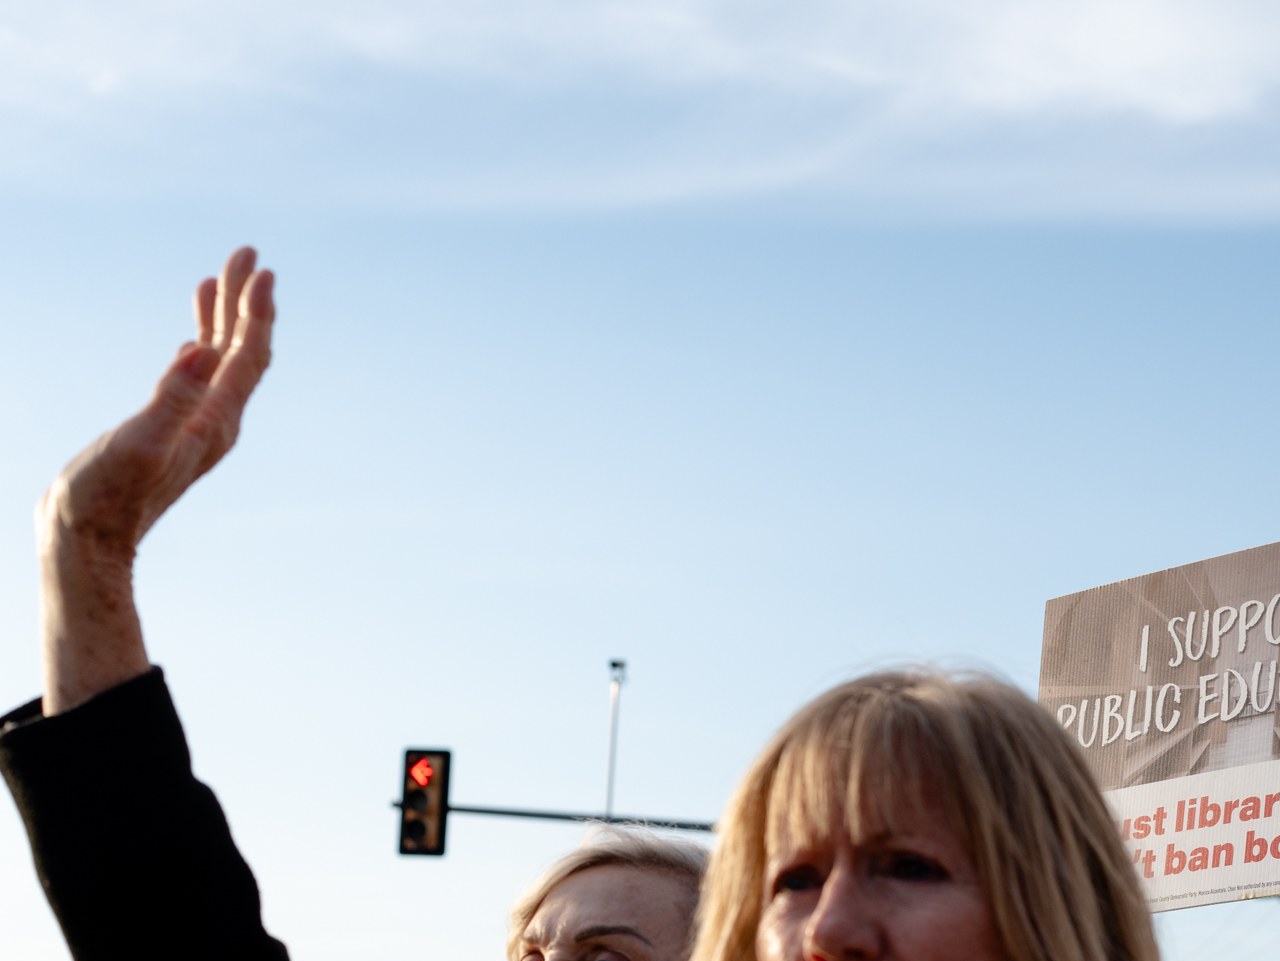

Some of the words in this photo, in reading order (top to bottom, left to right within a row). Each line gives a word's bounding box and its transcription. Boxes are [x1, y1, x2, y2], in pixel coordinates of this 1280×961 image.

[1138, 624, 1150, 673] I
[1056, 683, 1182, 748] PUBLIC
[1117, 806, 1168, 842] ust
[1163, 842, 1235, 877] ban
